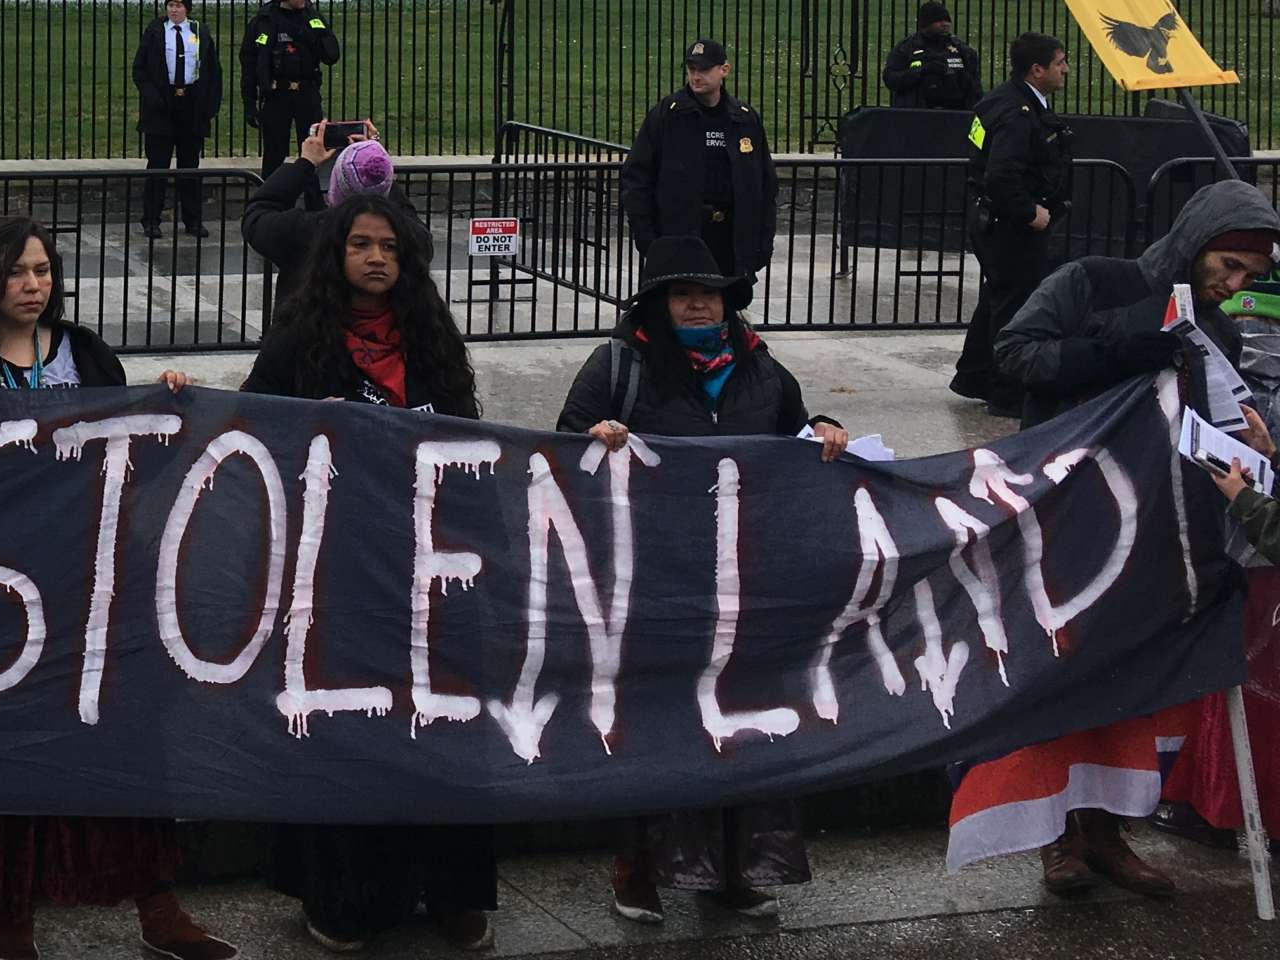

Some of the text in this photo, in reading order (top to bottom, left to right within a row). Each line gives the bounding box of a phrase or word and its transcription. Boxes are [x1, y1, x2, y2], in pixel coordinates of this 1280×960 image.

[476, 235, 513, 244] DO NOT
[478, 244, 511, 252] ENTER
